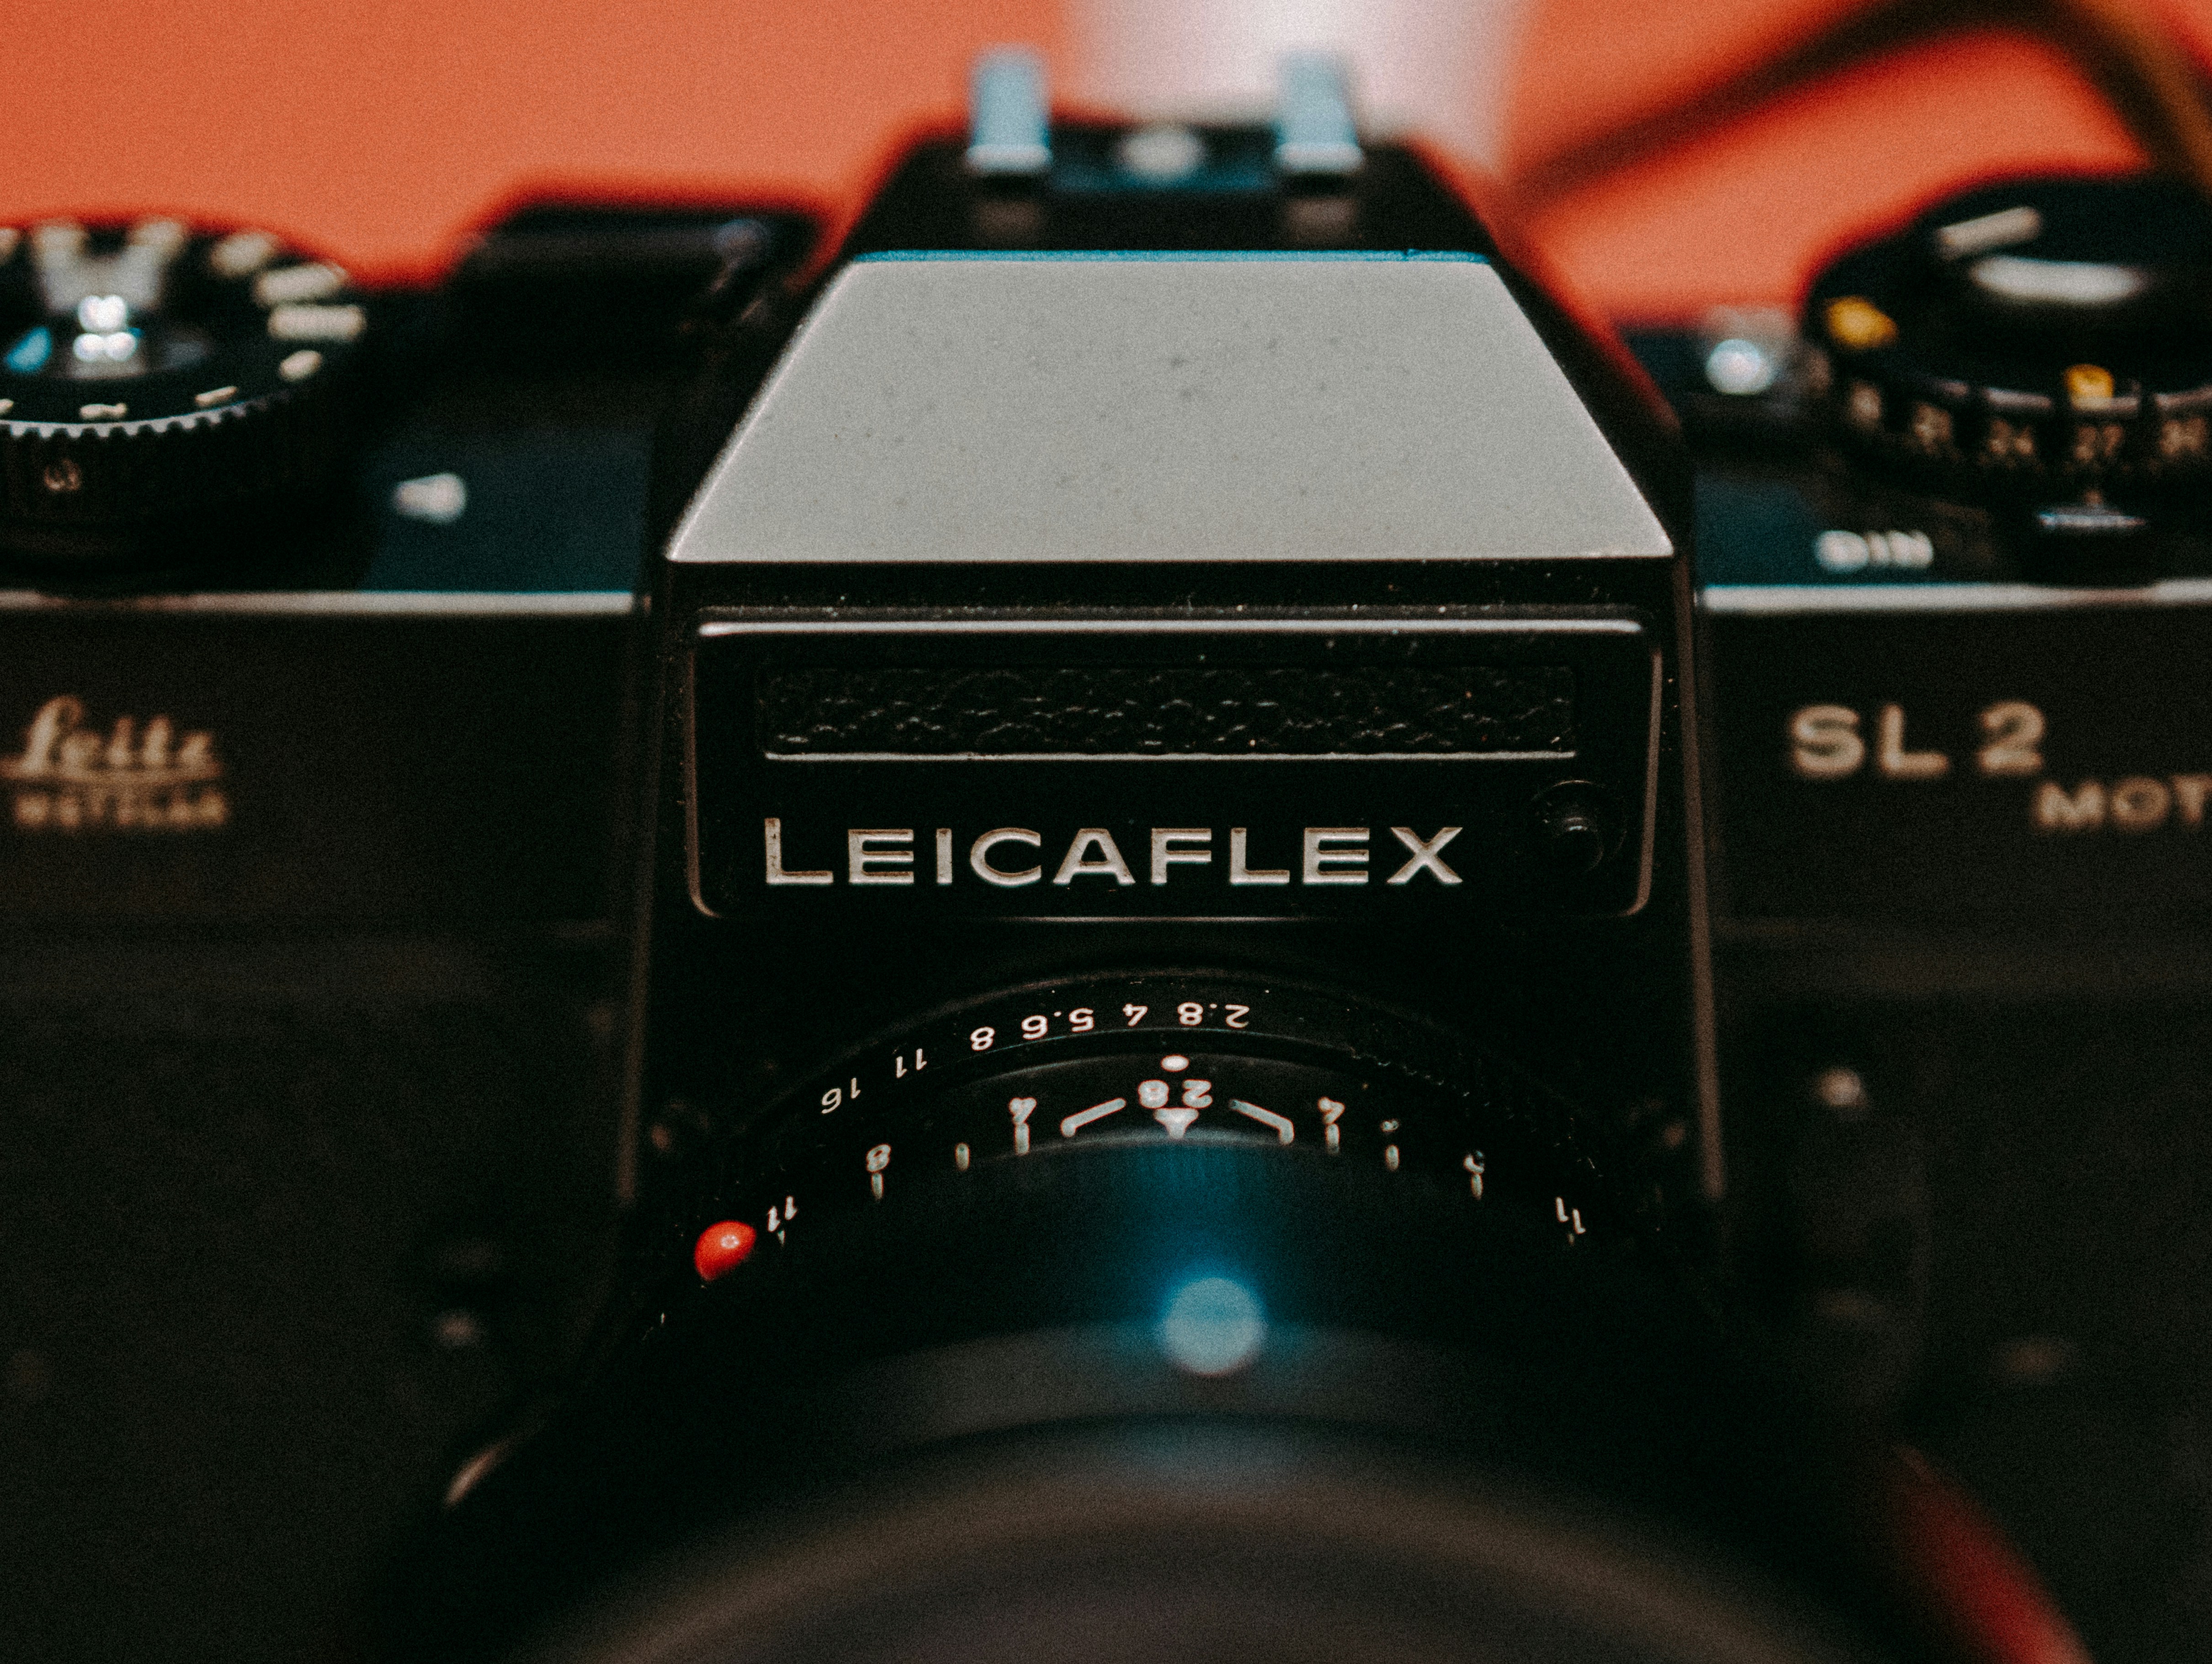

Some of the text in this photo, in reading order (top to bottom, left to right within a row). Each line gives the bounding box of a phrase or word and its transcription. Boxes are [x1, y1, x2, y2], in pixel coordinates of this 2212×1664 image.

[1791, 701, 2045, 777] SL 2
[765, 818, 1463, 885] LEICAFLEX
[821, 1002, 1250, 1114] 2.8 4 5.6 8 11 16
